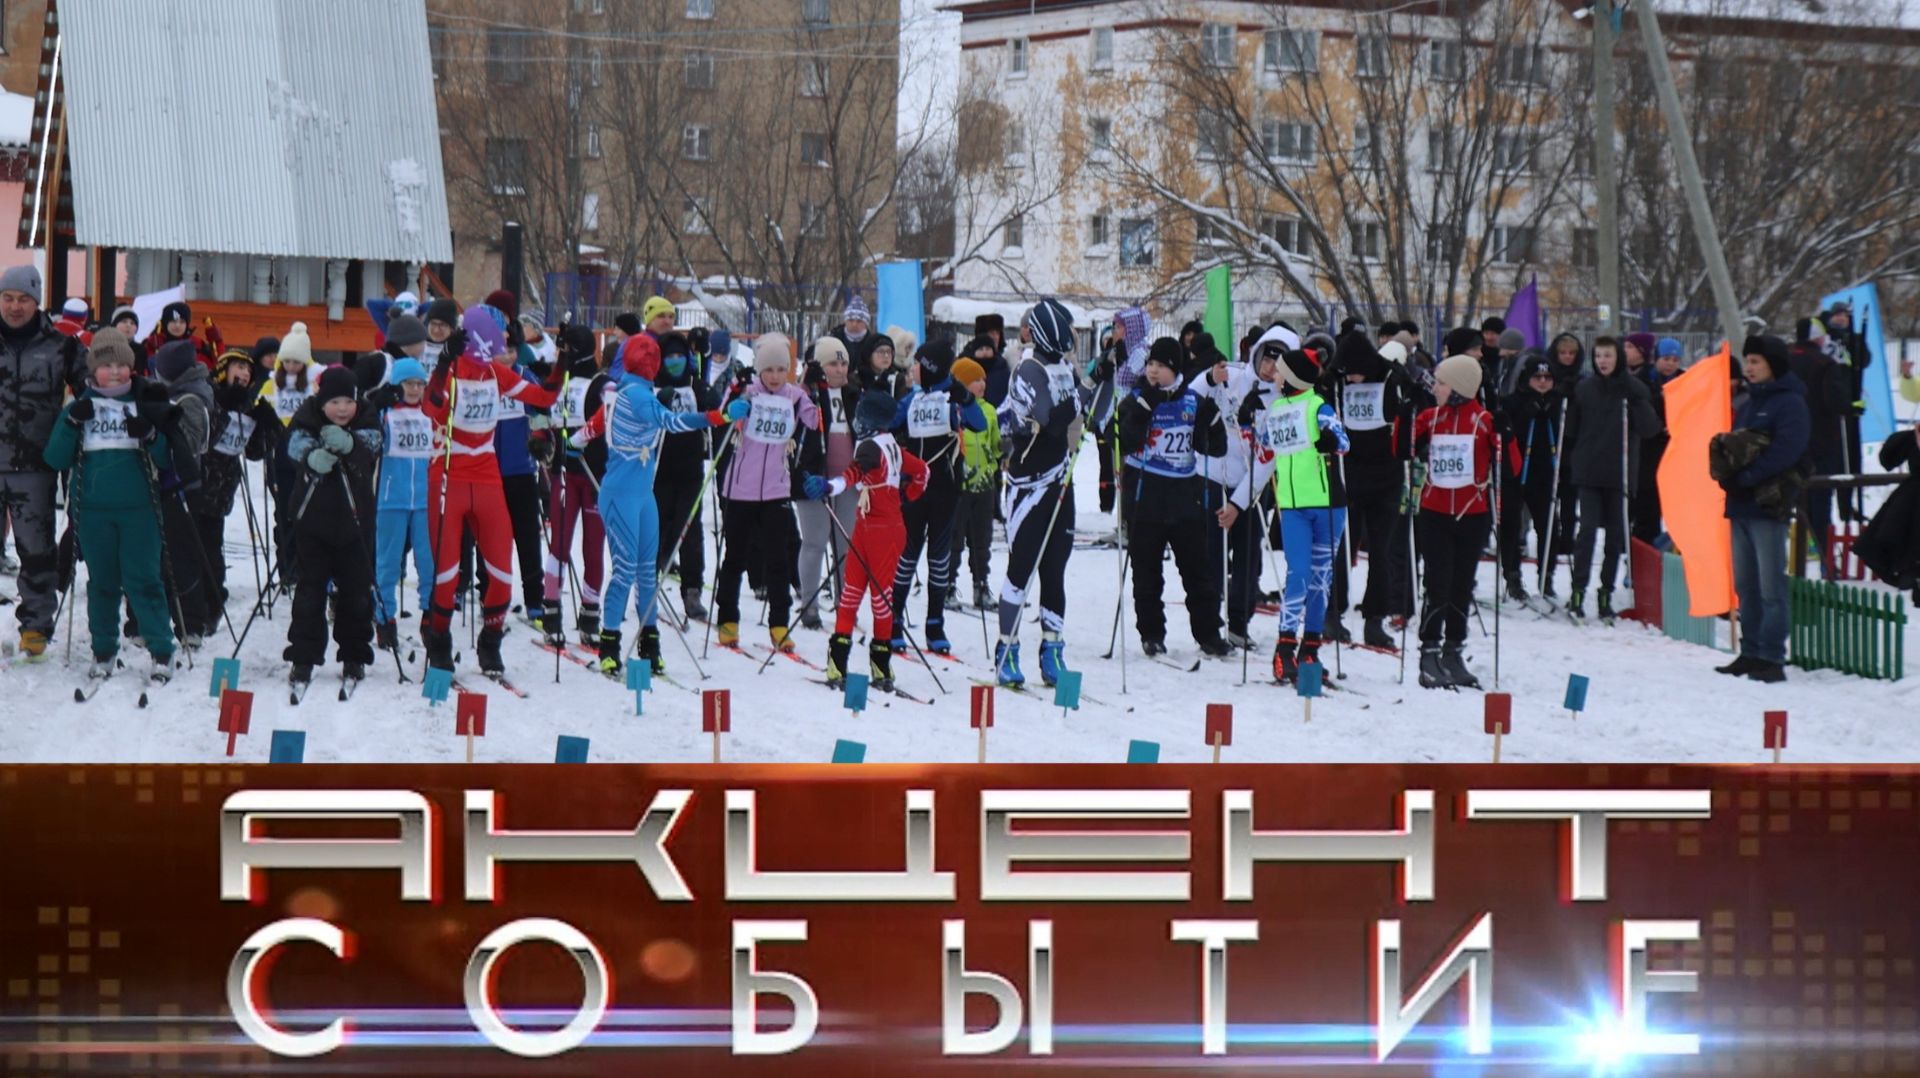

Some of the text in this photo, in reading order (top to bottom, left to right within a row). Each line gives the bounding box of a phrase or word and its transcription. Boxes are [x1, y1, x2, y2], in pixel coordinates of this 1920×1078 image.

[464, 402, 494, 419] 2277
[912, 407, 941, 423] 2042
[1348, 403, 1375, 418] 2036
[755, 418, 787, 436] 2030
[398, 432, 430, 448] 2019
[1272, 427, 1299, 445] 2024
[1432, 458, 1464, 473] 2096
